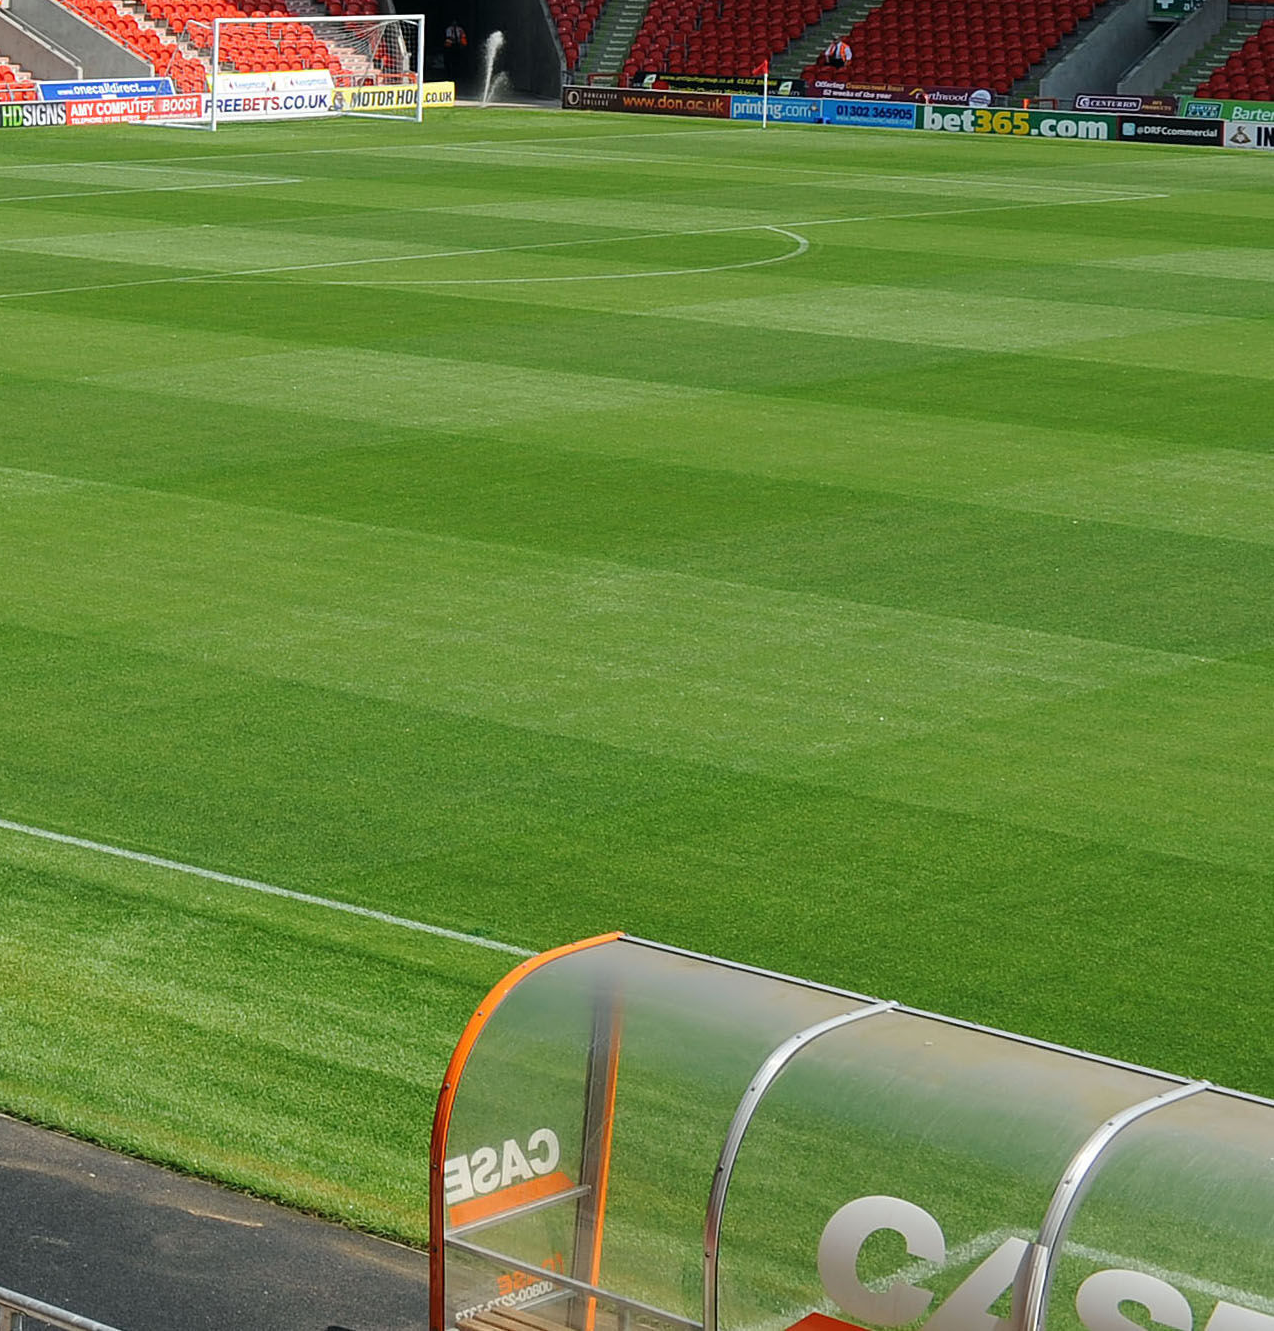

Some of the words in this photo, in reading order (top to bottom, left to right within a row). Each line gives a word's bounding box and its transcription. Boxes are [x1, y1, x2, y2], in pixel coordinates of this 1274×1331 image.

[204, 94, 328, 114] FREEBETS.CO.UK
[351, 90, 395, 107] MOTOR
[583, 92, 618, 100] DONCASTER
[583, 99, 610, 107] COLLEGE
[623, 95, 725, 112] www.don.ac.uk
[2, 103, 67, 127] HDSIGNS
[71, 103, 94, 117] AMY
[96, 100, 156, 116] COMPUTER
[162, 98, 198, 112] BOOST
[836, 105, 869, 118] 01302
[872, 107, 913, 120] 365905
[923, 106, 1109, 141] bet365.com
[1136, 124, 1218, 137] @DRFCcommercial
